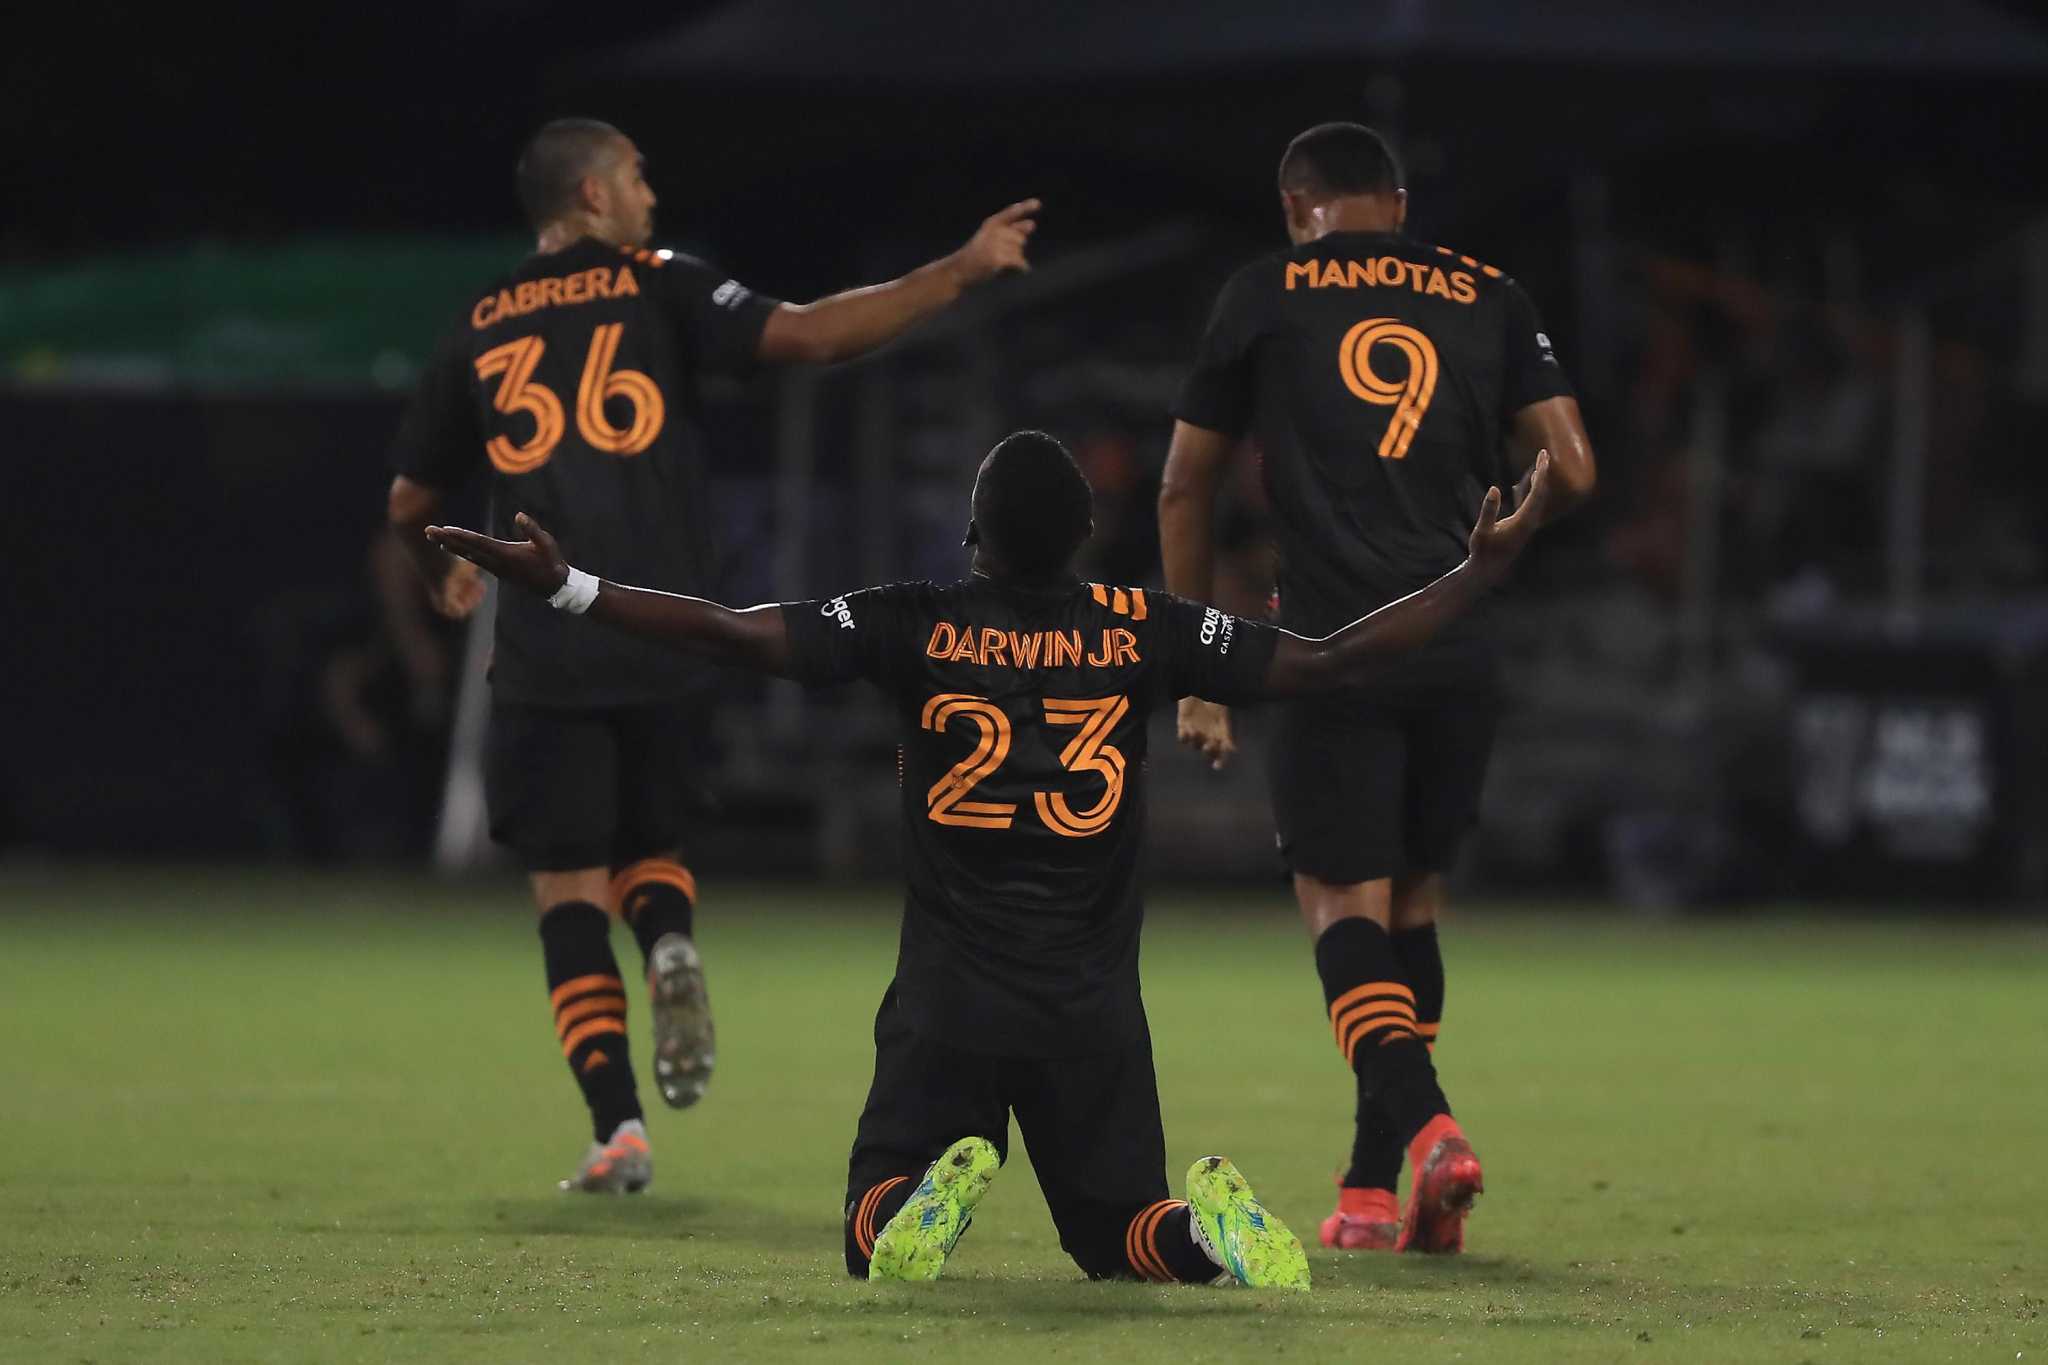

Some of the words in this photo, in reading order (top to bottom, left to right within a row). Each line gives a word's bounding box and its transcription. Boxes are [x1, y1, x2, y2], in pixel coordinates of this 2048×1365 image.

[471, 265, 640, 330] CABRERA
[1285, 256, 1478, 304] MANOTAS
[473, 321, 665, 474] 36
[1338, 316, 1440, 459] 9
[926, 621, 1083, 670] DARWIN
[1088, 627, 1142, 668] JR
[920, 692, 1130, 839] 23
